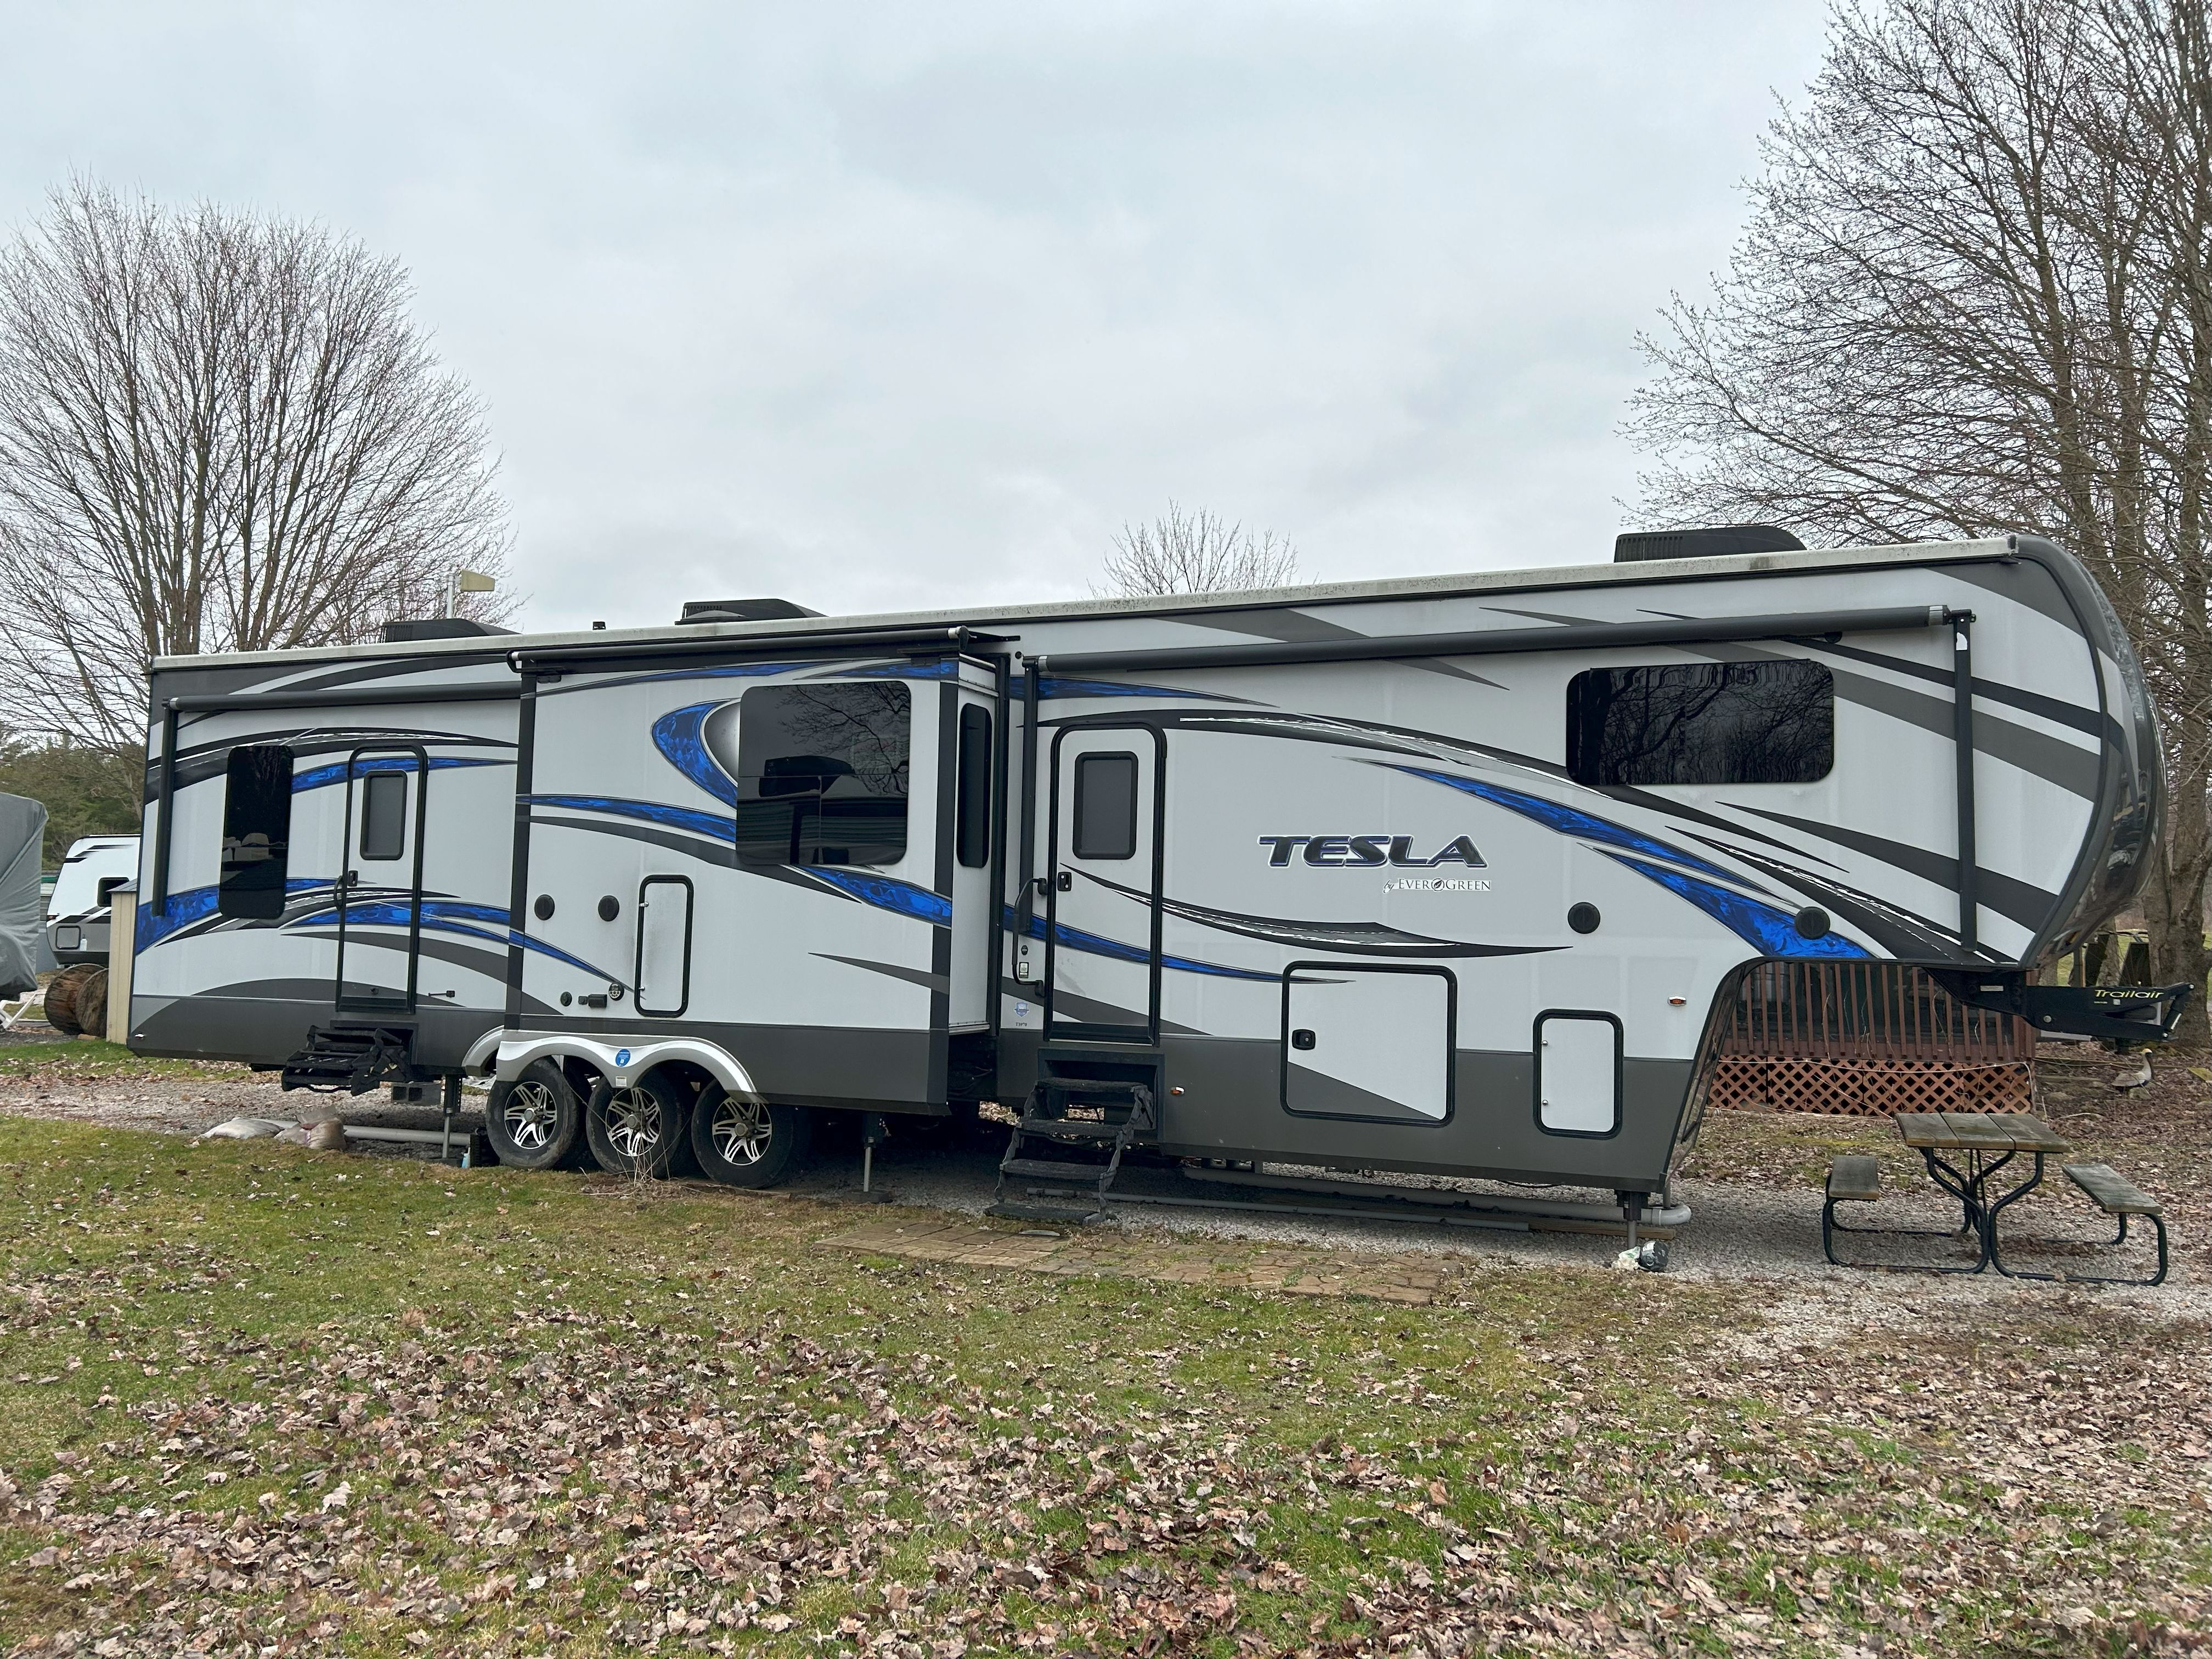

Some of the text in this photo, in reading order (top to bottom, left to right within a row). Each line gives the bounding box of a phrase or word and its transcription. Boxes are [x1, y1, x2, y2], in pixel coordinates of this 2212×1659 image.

[1259, 835, 1488, 868] TESLA
[1383, 879, 1395, 894] by
[2095, 989, 2164, 998] Trailair
